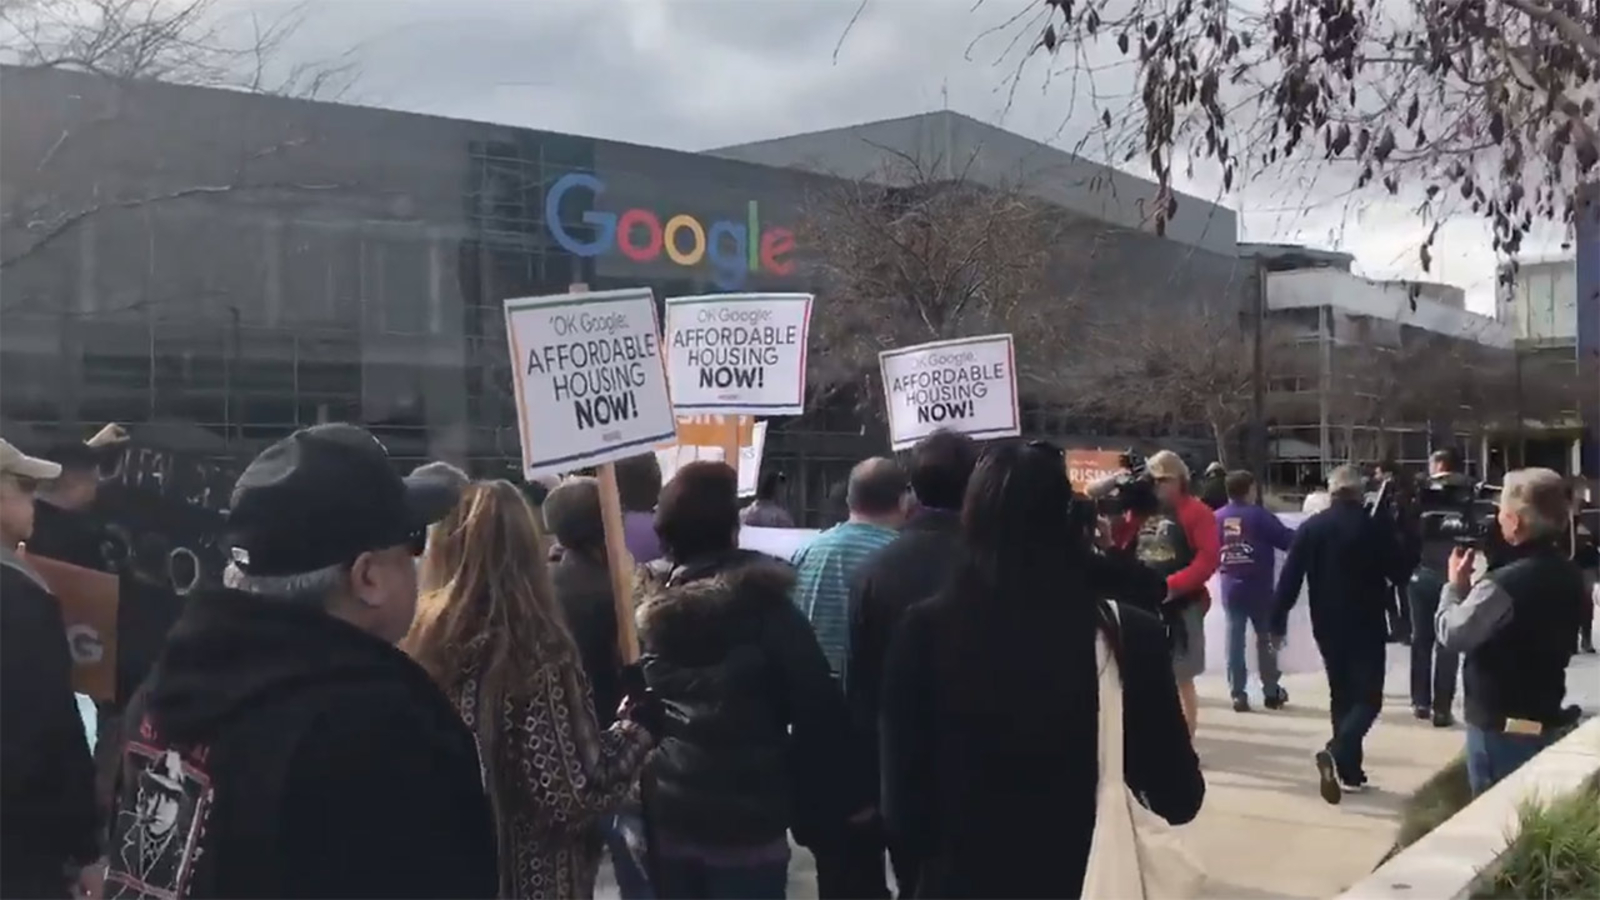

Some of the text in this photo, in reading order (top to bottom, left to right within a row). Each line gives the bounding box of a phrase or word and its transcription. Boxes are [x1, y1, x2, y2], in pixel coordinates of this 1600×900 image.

[545, 172, 796, 291] Google
[673, 325, 797, 347] AFFORDABLE
[527, 333, 656, 376] AFFORDABLE
[688, 347, 779, 367] HOUSING
[553, 363, 646, 401] HOUSING
[699, 366, 764, 388] NOW!
[893, 362, 1004, 393] AFFORDABLE
[906, 381, 988, 406] HOUSING
[574, 390, 639, 430] NOW!
[918, 399, 975, 423] NOW!
